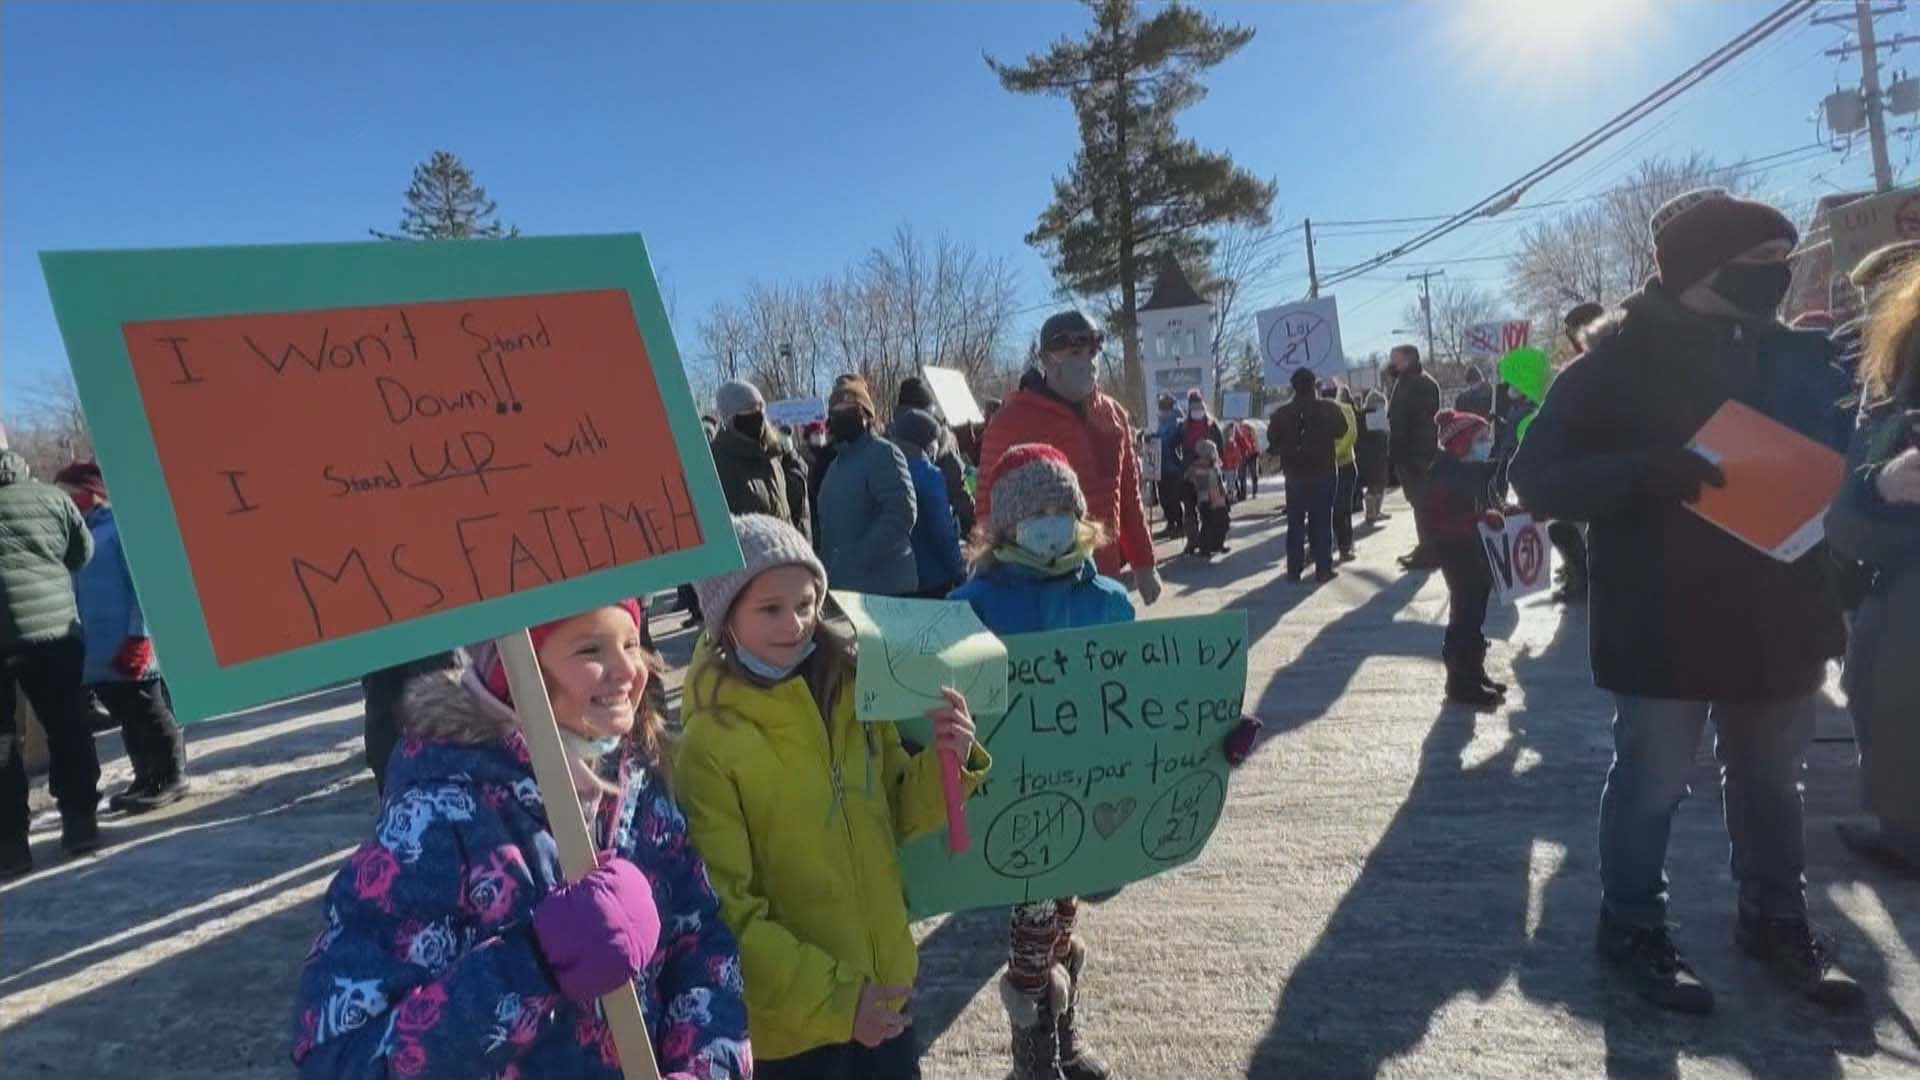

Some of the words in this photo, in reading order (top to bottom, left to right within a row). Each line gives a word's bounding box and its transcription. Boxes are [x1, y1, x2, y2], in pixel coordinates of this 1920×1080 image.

[157, 336, 206, 385] I
[242, 311, 419, 374] Won't
[460, 313, 552, 355] Stand
[1286, 336, 1310, 366] 21
[376, 350, 523, 426] Down!!
[217, 470, 259, 516] I
[323, 465, 404, 497] Stand
[409, 430, 497, 496] UP
[543, 413, 610, 460] with
[291, 545, 446, 638] MS
[454, 470, 704, 602] FATEMEH
[1084, 639, 1129, 673] for
[1141, 633, 1180, 665] all
[1199, 635, 1241, 669] by
[1171, 785, 1201, 815] Loi
[1012, 801, 1065, 844] Bill
[1158, 811, 1199, 848] 21
[1010, 845, 1050, 869] 21
